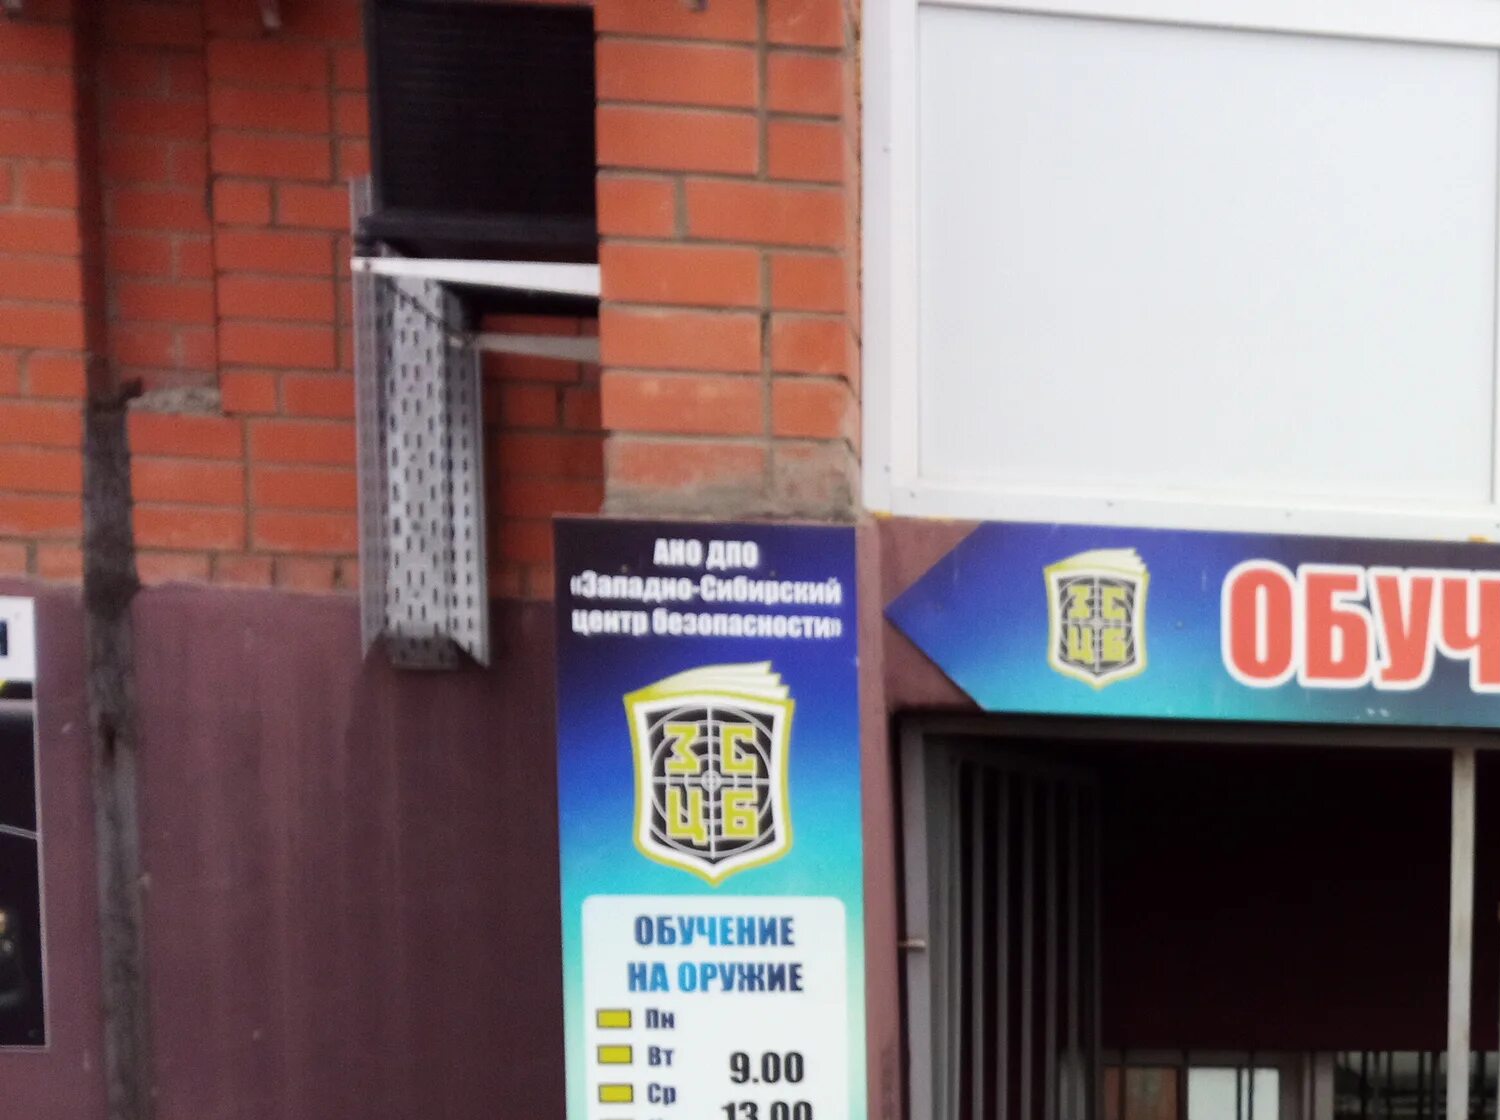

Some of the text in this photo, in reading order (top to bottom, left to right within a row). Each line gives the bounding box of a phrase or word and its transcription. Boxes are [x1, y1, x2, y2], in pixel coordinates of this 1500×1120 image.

[653, 537, 759, 570] АНО ДПО
[571, 608, 648, 636] центр
[634, 915, 796, 947] ОБУЧЕНИЕ
[627, 961, 804, 993] НА ОРУЖИЕ
[645, 1008, 675, 1030] Пн
[647, 1045, 675, 1067] Вт
[729, 1050, 805, 1084] 9.00
[647, 1083, 677, 1105] Ср
